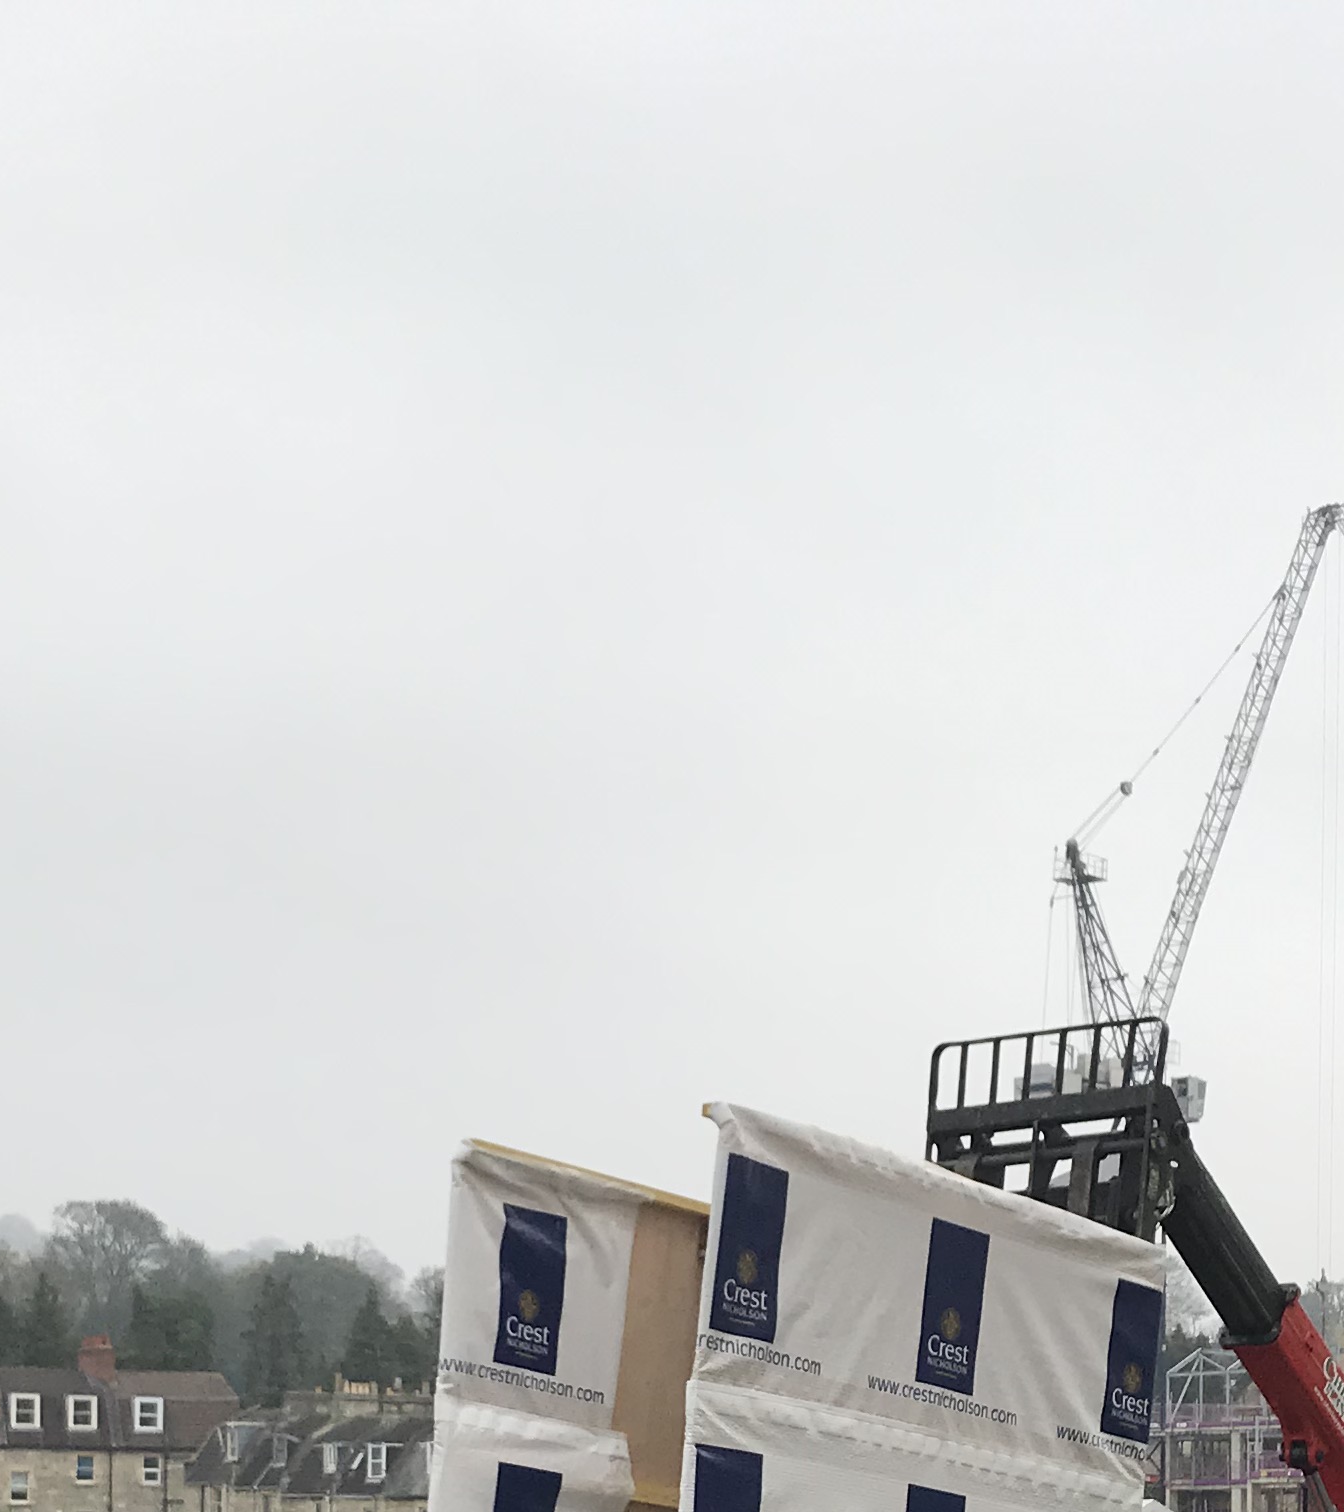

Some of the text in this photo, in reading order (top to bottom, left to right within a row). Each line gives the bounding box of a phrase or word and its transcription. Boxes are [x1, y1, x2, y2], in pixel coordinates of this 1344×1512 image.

[723, 1278, 768, 1311] Crest
[722, 1302, 767, 1321] NICHOLSON
[506, 1315, 551, 1345] Crest
[697, 1333, 821, 1376] restnicholson.com
[927, 1334, 969, 1365] Crest
[439, 1357, 605, 1404] www.crestnicholson.com
[867, 1374, 1017, 1426] www.crestnicholson.com
[1112, 1387, 1150, 1416] Crest
[1056, 1425, 1146, 1461] www.crestnicho
